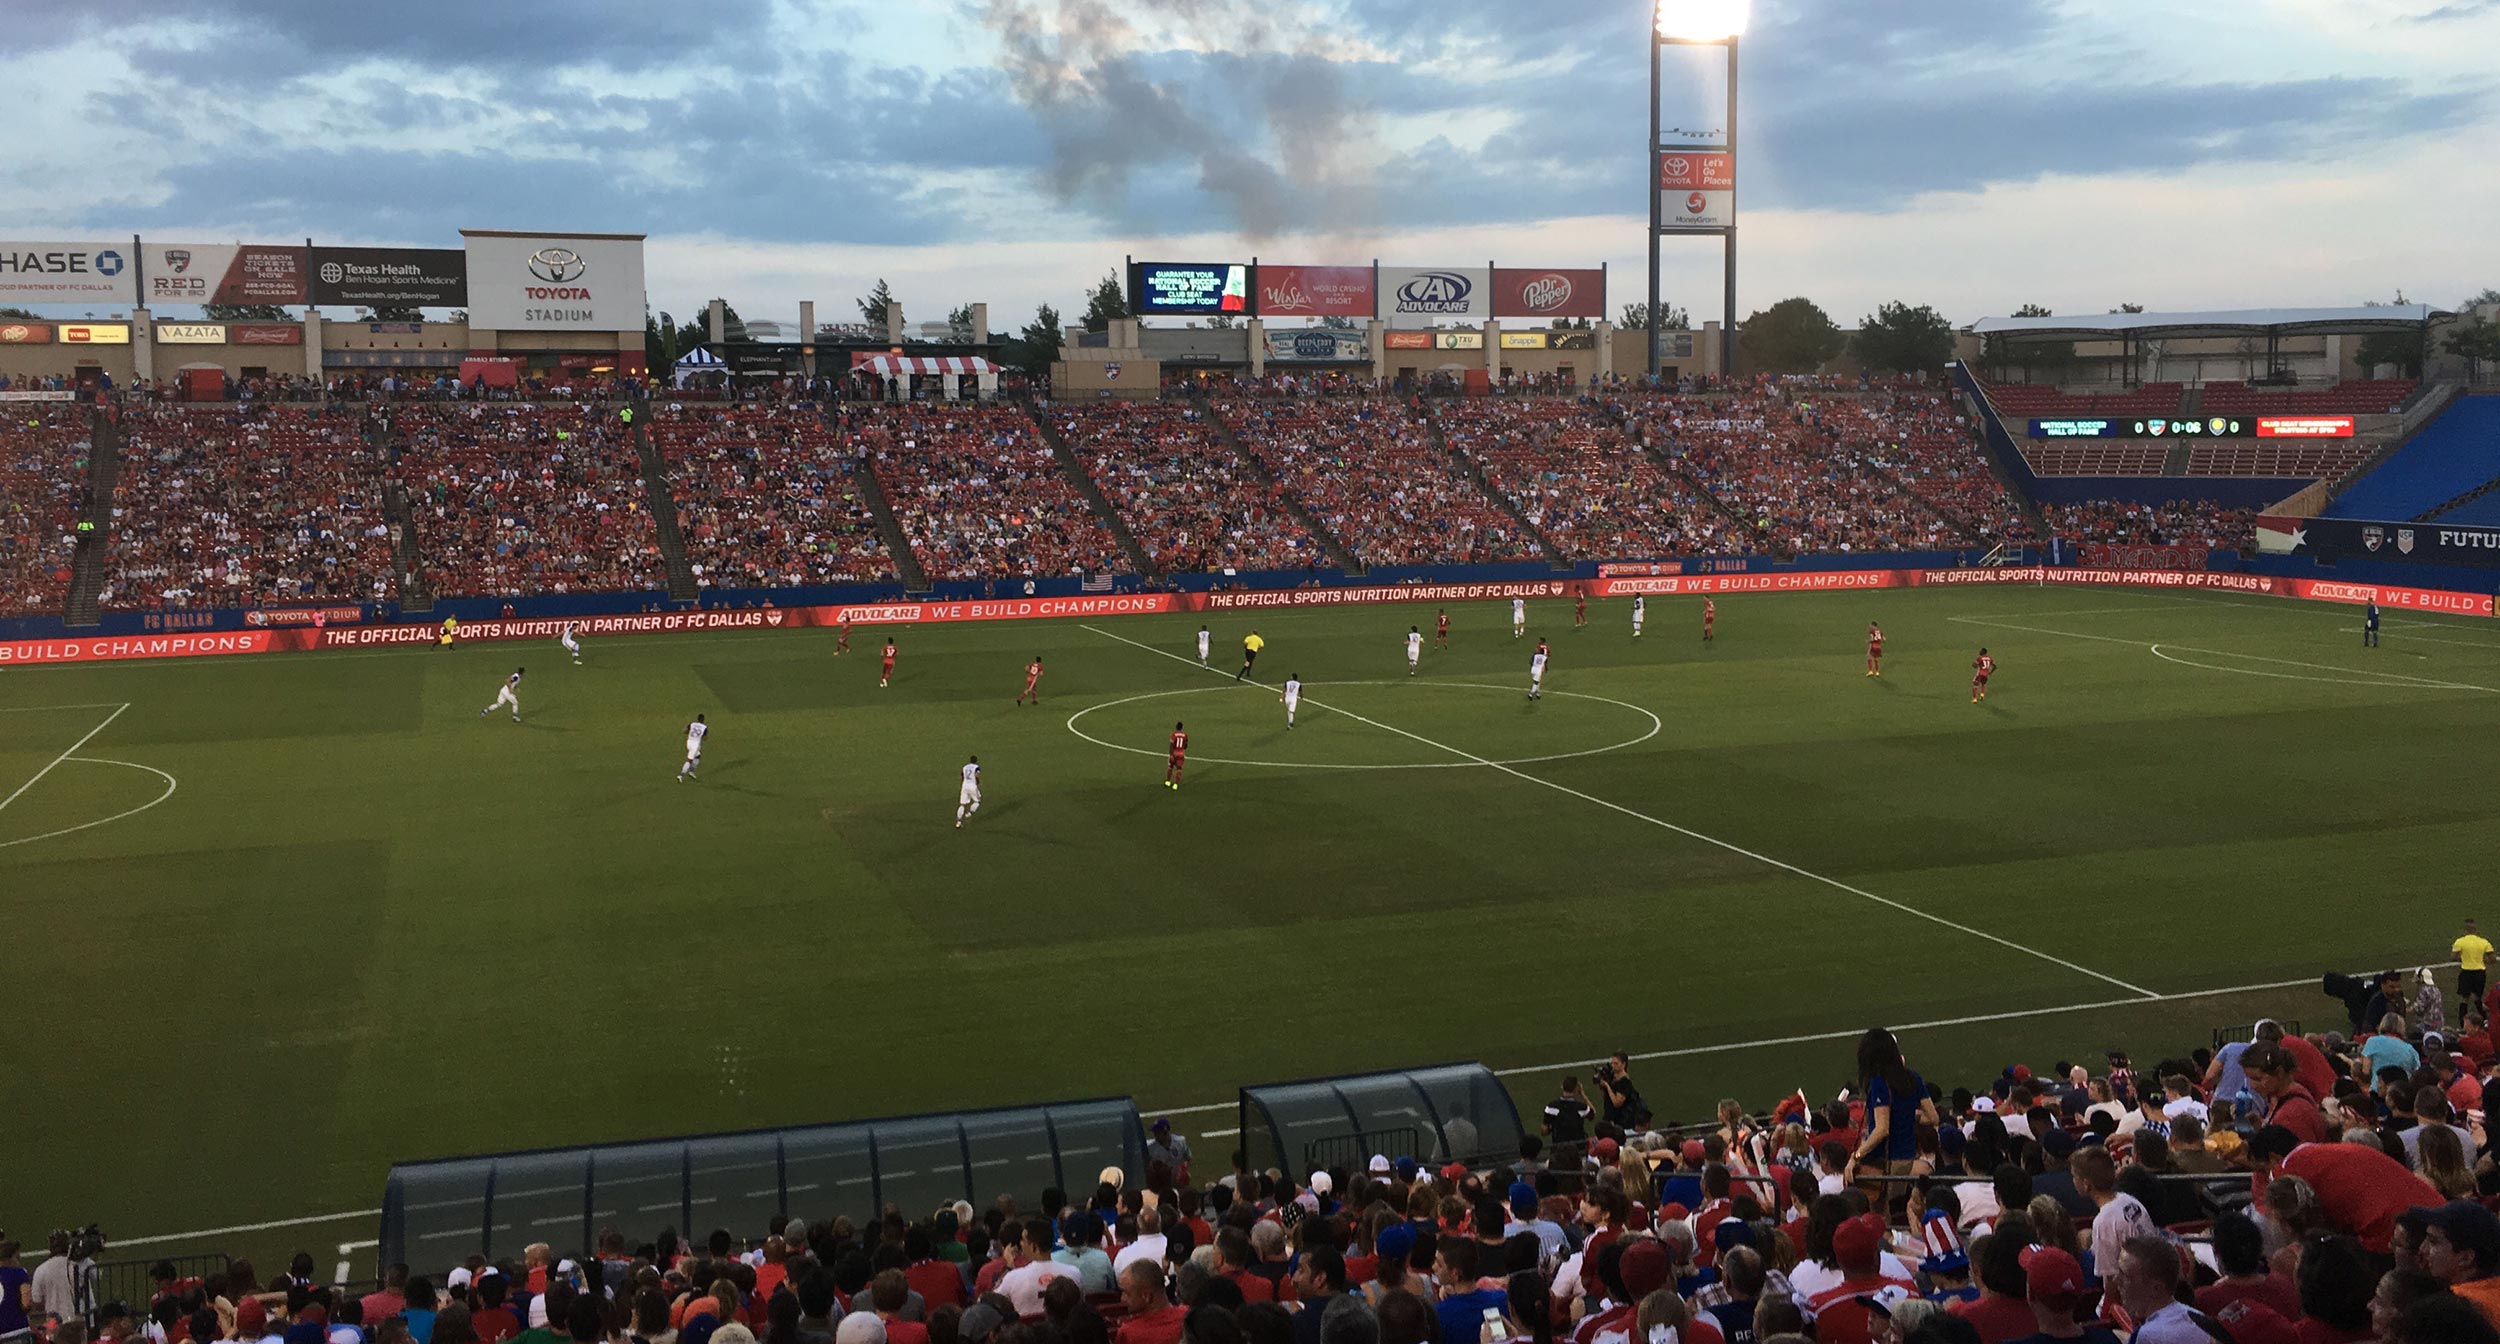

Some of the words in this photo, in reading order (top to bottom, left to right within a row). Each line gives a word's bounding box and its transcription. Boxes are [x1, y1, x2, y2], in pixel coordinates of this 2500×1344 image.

[1704, 158, 1723, 167] Let's
[1703, 167, 1716, 176] Go
[1662, 177, 1691, 185] TOYOTA
[1703, 176, 1732, 185] Places
[1675, 216, 1718, 225] MoneyGram
[0, 252, 88, 273] HASE
[344, 263, 379, 275] Texas
[381, 264, 421, 275] Health
[345, 275, 361, 283] Ben
[362, 275, 391, 285] Hogan
[393, 276, 419, 286] Sports
[1155, 271, 1195, 279] GUARANTEE
[1195, 271, 1215, 279] YOUR
[154, 278, 206, 289] RED
[1312, 285, 1338, 293] WORLD
[1339, 285, 1366, 293] CASINO
[1540, 279, 1557, 292] Dr
[341, 291, 440, 301] TexasHealth.org/BenHogan
[525, 287, 592, 300] TOYOTA
[1263, 278, 1312, 310] WinStar
[1528, 281, 1568, 308] Pepper
[1152, 297, 1196, 305] MEMBERSHIP
[1325, 297, 1352, 305] RESORT
[1396, 300, 1470, 313] ADVOCARE
[525, 309, 593, 321] STADIUM
[162, 327, 220, 337] VAZATA
[2040, 421, 2077, 429] NATIONAL
[2077, 421, 2107, 429] SOCCER
[2134, 421, 2144, 434] 0
[2171, 421, 2202, 434] 0:06
[2229, 421, 2240, 434] 0
[2439, 530, 2500, 548] FUTU
[1608, 578, 1678, 594] ADVOCARE
[1686, 579, 1712, 592] WE
[1719, 576, 1771, 590] BUILD
[1777, 573, 1879, 588] CHAMPIONS
[1925, 571, 1945, 583] THE
[1948, 570, 1997, 582] OFFICIAL
[1999, 569, 2044, 581] SPORTS
[2047, 569, 2120, 583] NUTRITION
[2123, 571, 2183, 585] PARTNER
[2186, 574, 2204, 585] OF
[2207, 575, 2221, 586] FC
[2222, 576, 2257, 589] DALLAS
[1210, 594, 1233, 607] THE
[1235, 592, 1291, 606] OFFICIAL
[1294, 590, 1341, 604] SPORTS
[1343, 588, 1409, 602] NUTRITION
[1412, 585, 1465, 599] PARTNER
[1468, 585, 1484, 598] OF
[1486, 583, 1501, 597] FC
[1503, 583, 1547, 597] DALLAS
[2311, 583, 2377, 601] ADVOCARE
[2386, 590, 2412, 604] WE
[2420, 594, 2474, 610] BUILD
[269, 612, 310, 621] TOYOTA
[318, 610, 360, 620] TADIUM
[837, 606, 921, 623] ADVOCARE
[932, 606, 962, 619] WE
[971, 603, 1032, 617] BUILD
[1039, 598, 1157, 614] CHAMPIONS
[144, 614, 160, 629] FC
[164, 612, 213, 628] DALLAS
[326, 631, 356, 645] THE
[361, 627, 435, 643] OFFICIAL
[594, 616, 661, 632] PARTNER
[664, 615, 683, 628] OF
[687, 614, 704, 627] FC
[708, 612, 762, 627] DALLAS
[0, 644, 80, 660] BUILD
[93, 636, 252, 656] CHAMPIONS
[690, 728, 701, 737] 29
[1176, 737, 1184, 748] 11
[965, 769, 973, 780] 12
